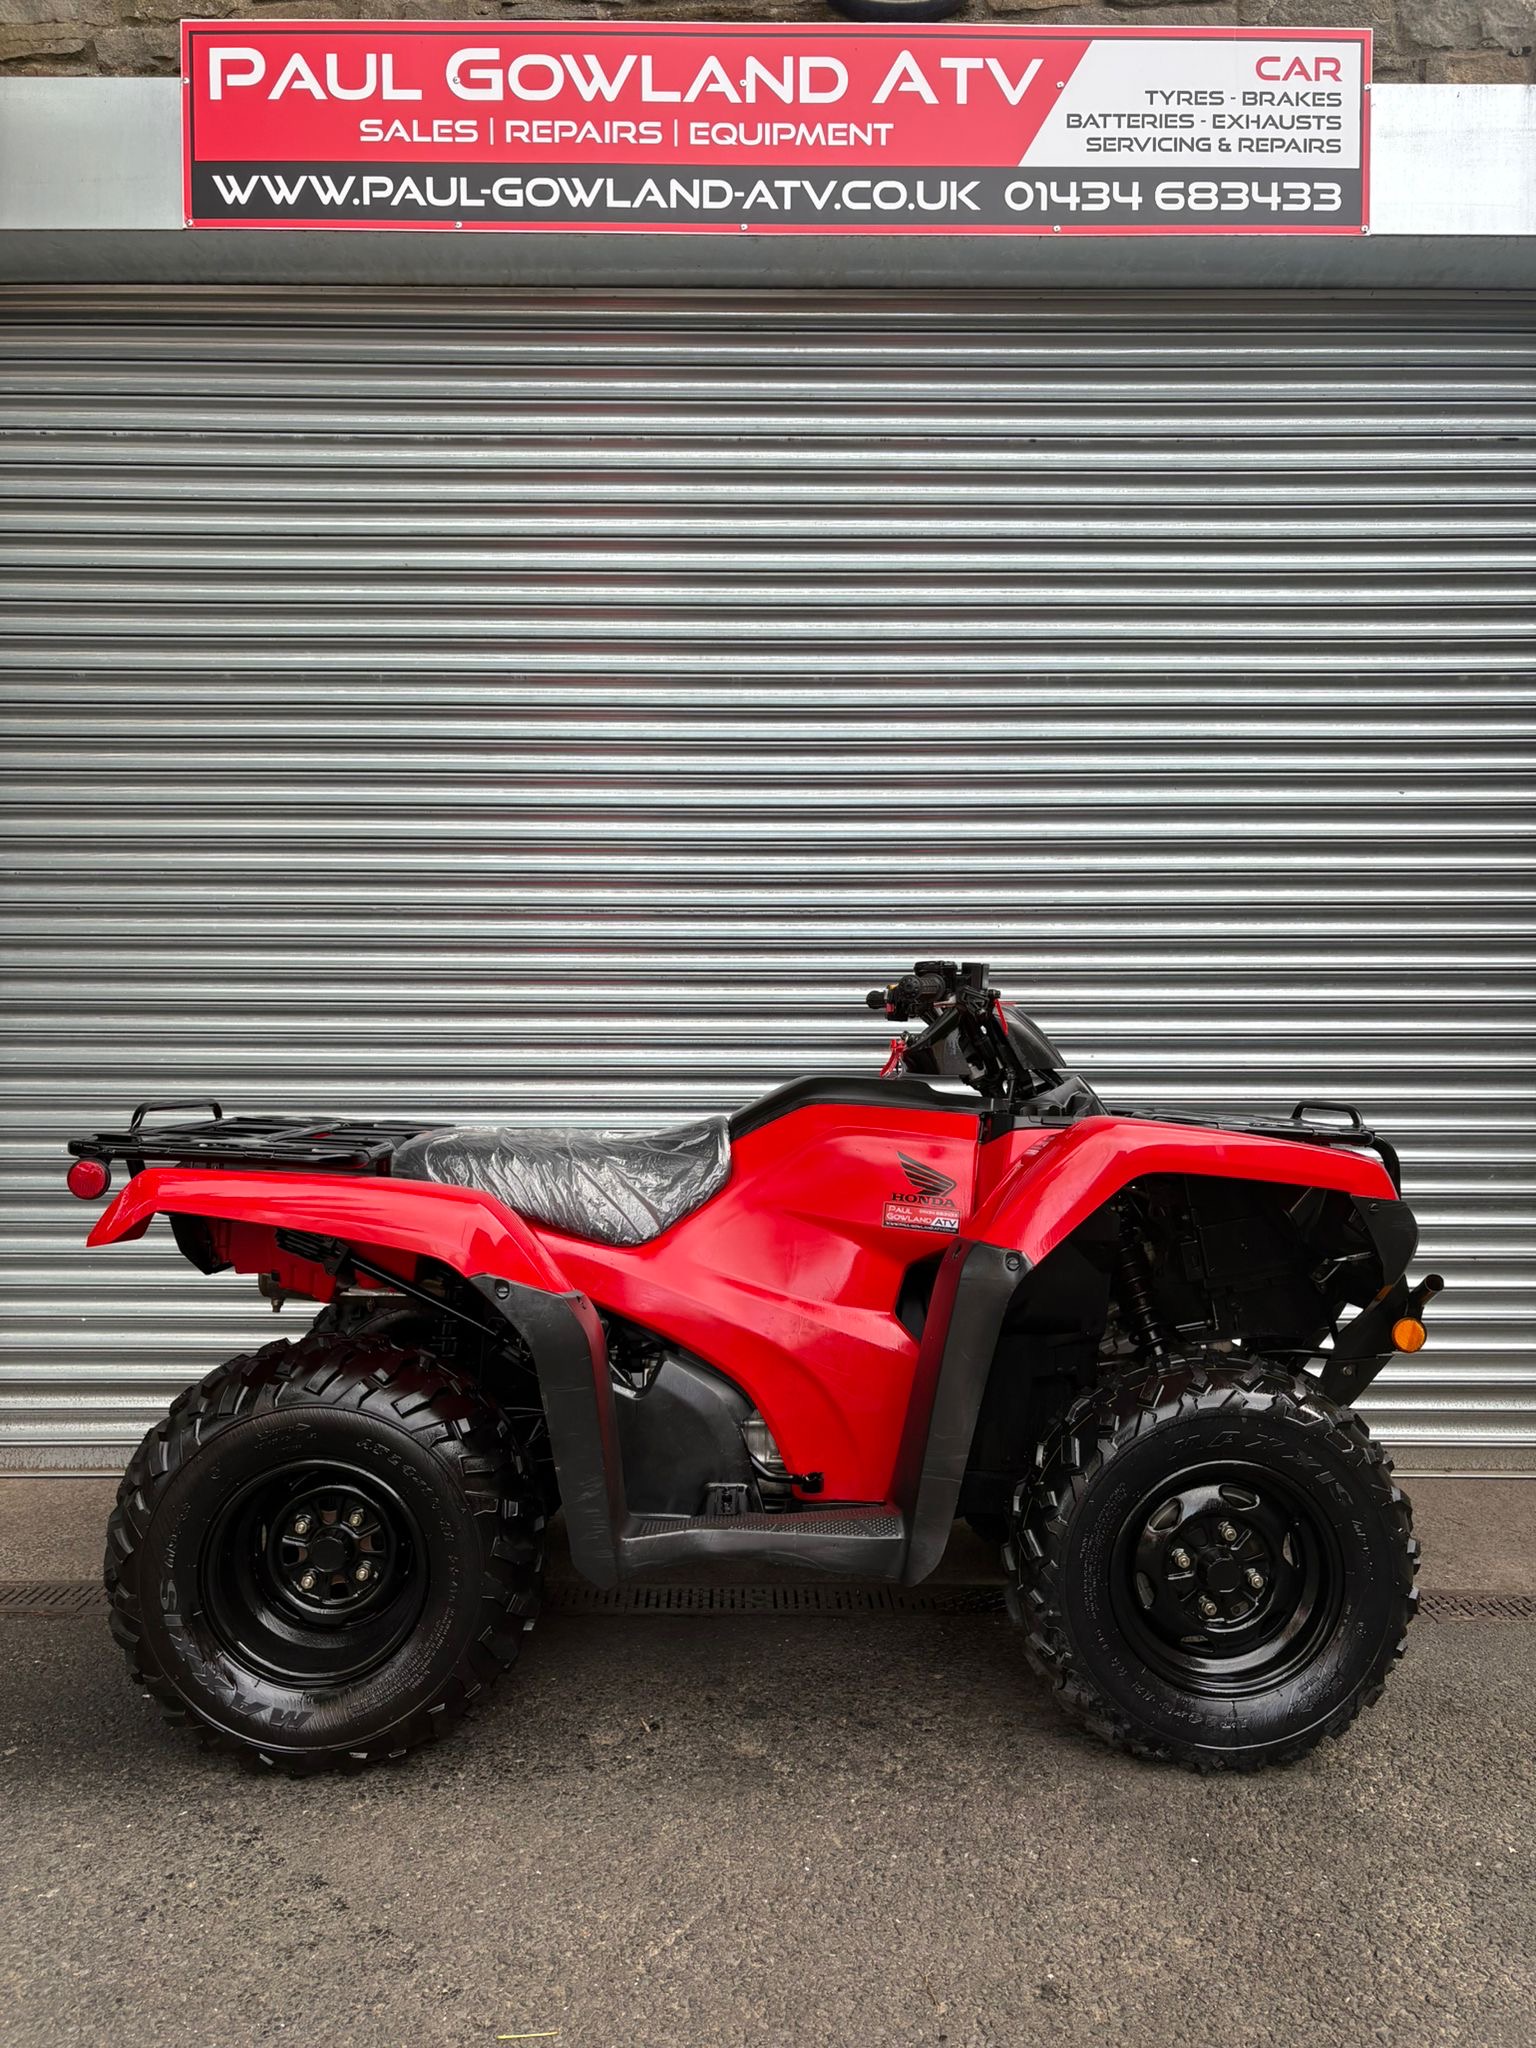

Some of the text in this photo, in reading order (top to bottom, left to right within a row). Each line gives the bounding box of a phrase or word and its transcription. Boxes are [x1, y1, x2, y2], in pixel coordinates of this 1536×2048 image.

[209, 47, 1044, 106] PAUL GOWLAND ATV
[1255, 56, 1342, 82] CAR
[1144, 90, 1225, 106] TYRES
[1242, 91, 1342, 107] BRAKES
[1066, 113, 1195, 129] BATTERIES
[1212, 114, 1342, 131] EXHAUSTS
[359, 119, 479, 143] SALES
[505, 120, 663, 145] REPAIRS
[689, 121, 894, 146] EQUIPMENT
[1086, 136, 1342, 154] SERVICING & REPAIRS
[211, 175, 1342, 212] WWW.PAUL-GOWLAND-ATV.CO.UK 01434 683433
[892, 1193, 955, 1207] HONDA
[888, 1205, 912, 1214] PAUL
[886, 1213, 932, 1224] GOWLAND
[934, 1218, 957, 1228] ATV
